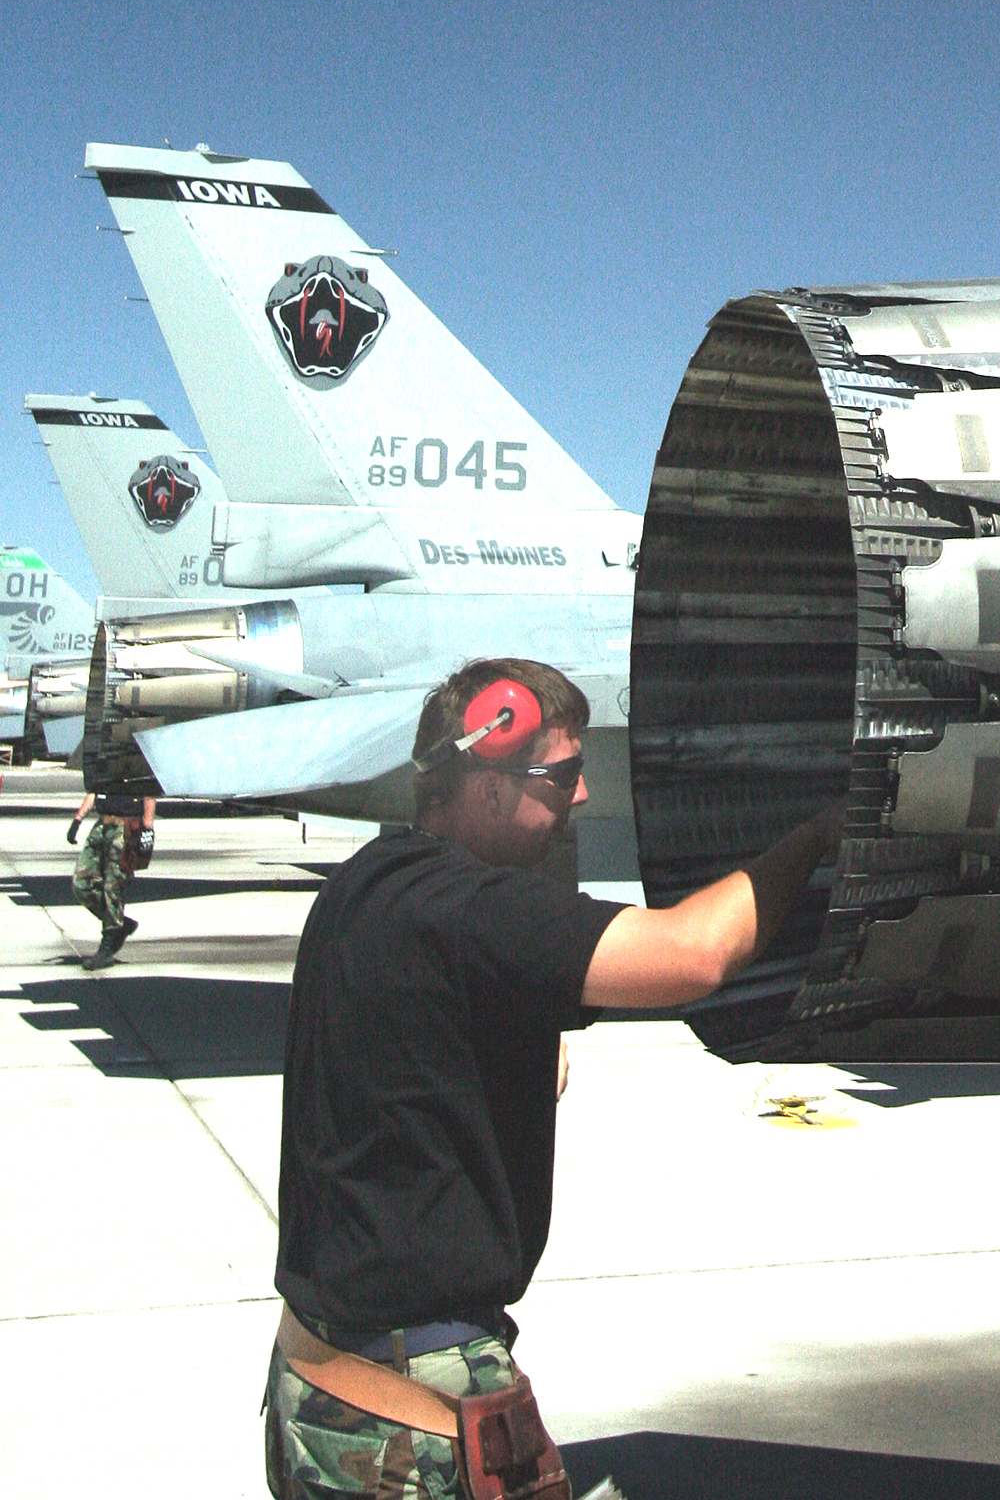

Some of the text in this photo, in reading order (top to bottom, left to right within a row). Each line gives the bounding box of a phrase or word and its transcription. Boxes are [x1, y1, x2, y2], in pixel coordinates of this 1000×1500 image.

[176, 180, 282, 208] IOWA
[79, 412, 140, 428] IOWA
[370, 436, 408, 458] AF
[368, 464, 408, 487] 89
[414, 438, 528, 492] 045
[180, 555, 199, 569] AF
[418, 538, 567, 567] DES MOINES
[6, 572, 48, 598] OH
[179, 572, 198, 586] 89
